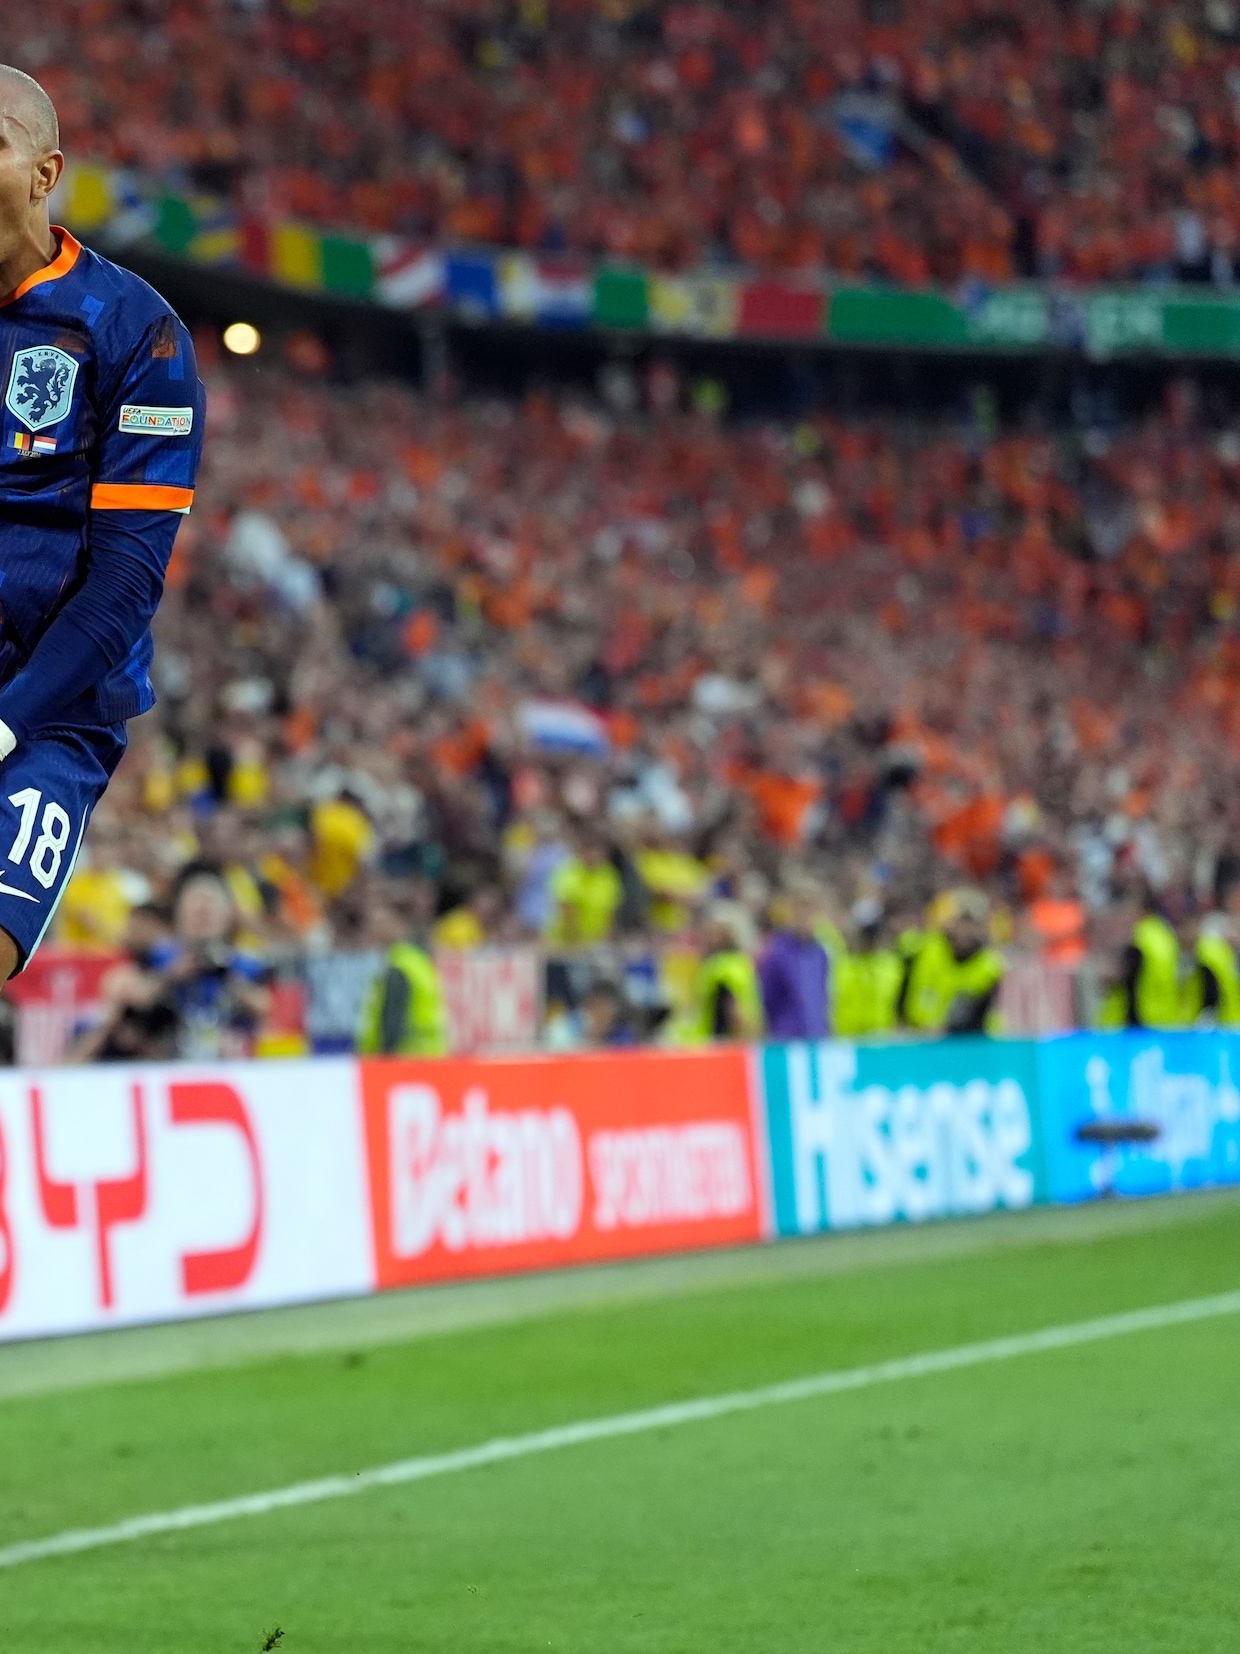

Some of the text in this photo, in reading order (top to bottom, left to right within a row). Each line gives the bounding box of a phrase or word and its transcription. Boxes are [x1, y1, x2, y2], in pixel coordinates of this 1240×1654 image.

[122, 414, 191, 427] FOUNDATION
[123, 407, 142, 415] UEFA
[8, 787, 70, 889] 18
[386, 1082, 584, 1259] Betano
[786, 1040, 1033, 1234] Hisense
